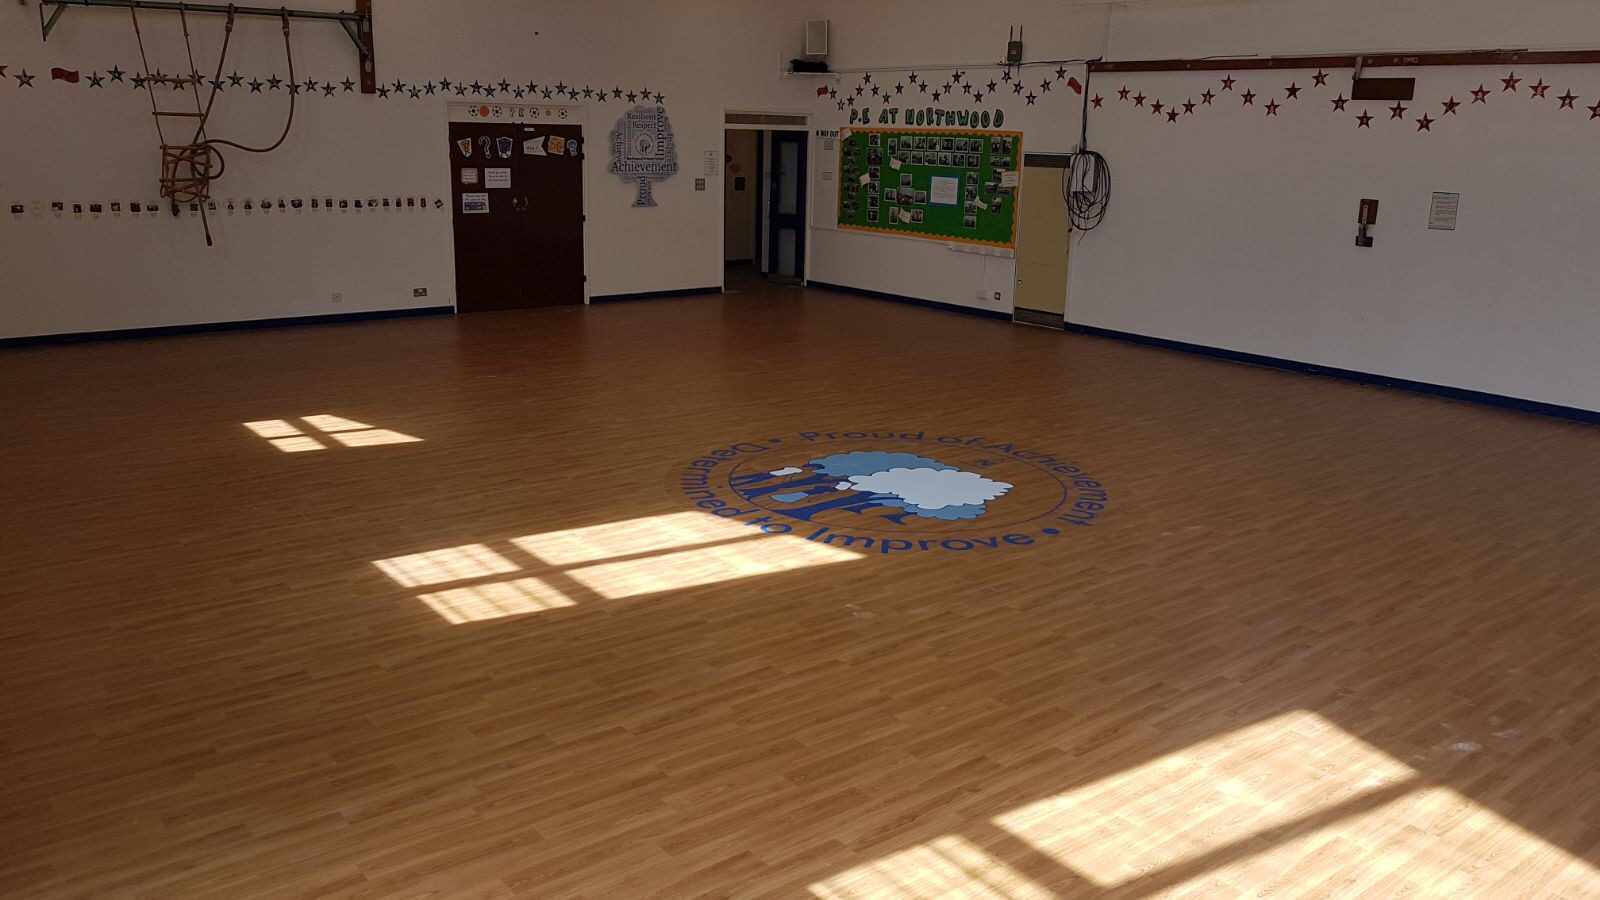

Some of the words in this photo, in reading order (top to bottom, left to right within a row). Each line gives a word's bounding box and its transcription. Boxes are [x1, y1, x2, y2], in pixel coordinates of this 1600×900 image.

[627, 113, 657, 121] Resilient
[632, 121, 657, 130] Respect
[655, 107, 666, 156] Improve
[849, 107, 871, 125] P.E
[879, 108, 898, 125] AT
[905, 108, 1004, 128] NORTHWOOD
[616, 131, 624, 164] Achieve
[611, 161, 677, 172] Achievement
[637, 176, 646, 206] Proud
[799, 431, 924, 442] Proud
[937, 435, 984, 445] of
[983, 444, 1108, 527] Achievement
[680, 443, 768, 518] Determined
[744, 516, 792, 534] to
[806, 526, 1036, 554] Improve
